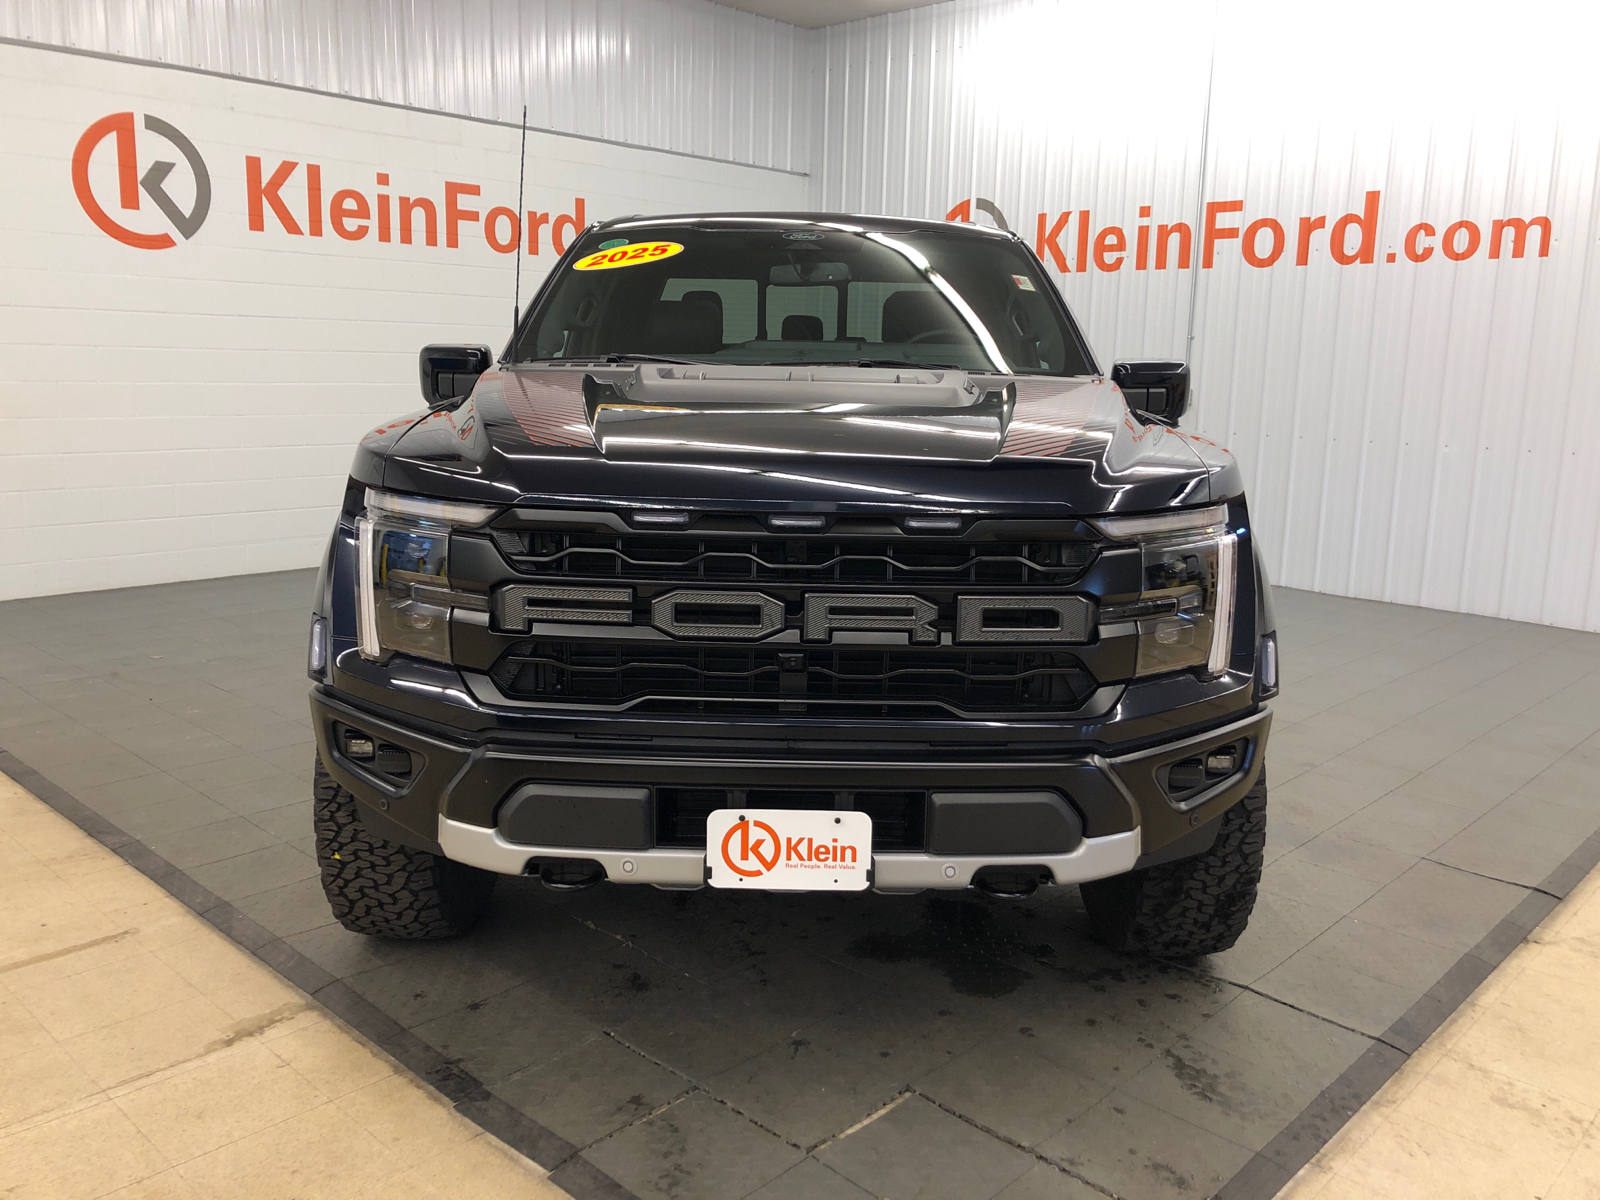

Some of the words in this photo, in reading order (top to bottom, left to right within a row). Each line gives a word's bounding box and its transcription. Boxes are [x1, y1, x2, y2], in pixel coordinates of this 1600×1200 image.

[245, 154, 587, 257] KleinFord
[1036, 190, 1553, 274] KleinFord.com
[584, 244, 672, 268] 2025
[494, 584, 1097, 645] FORD
[786, 837, 857, 863] Klein
